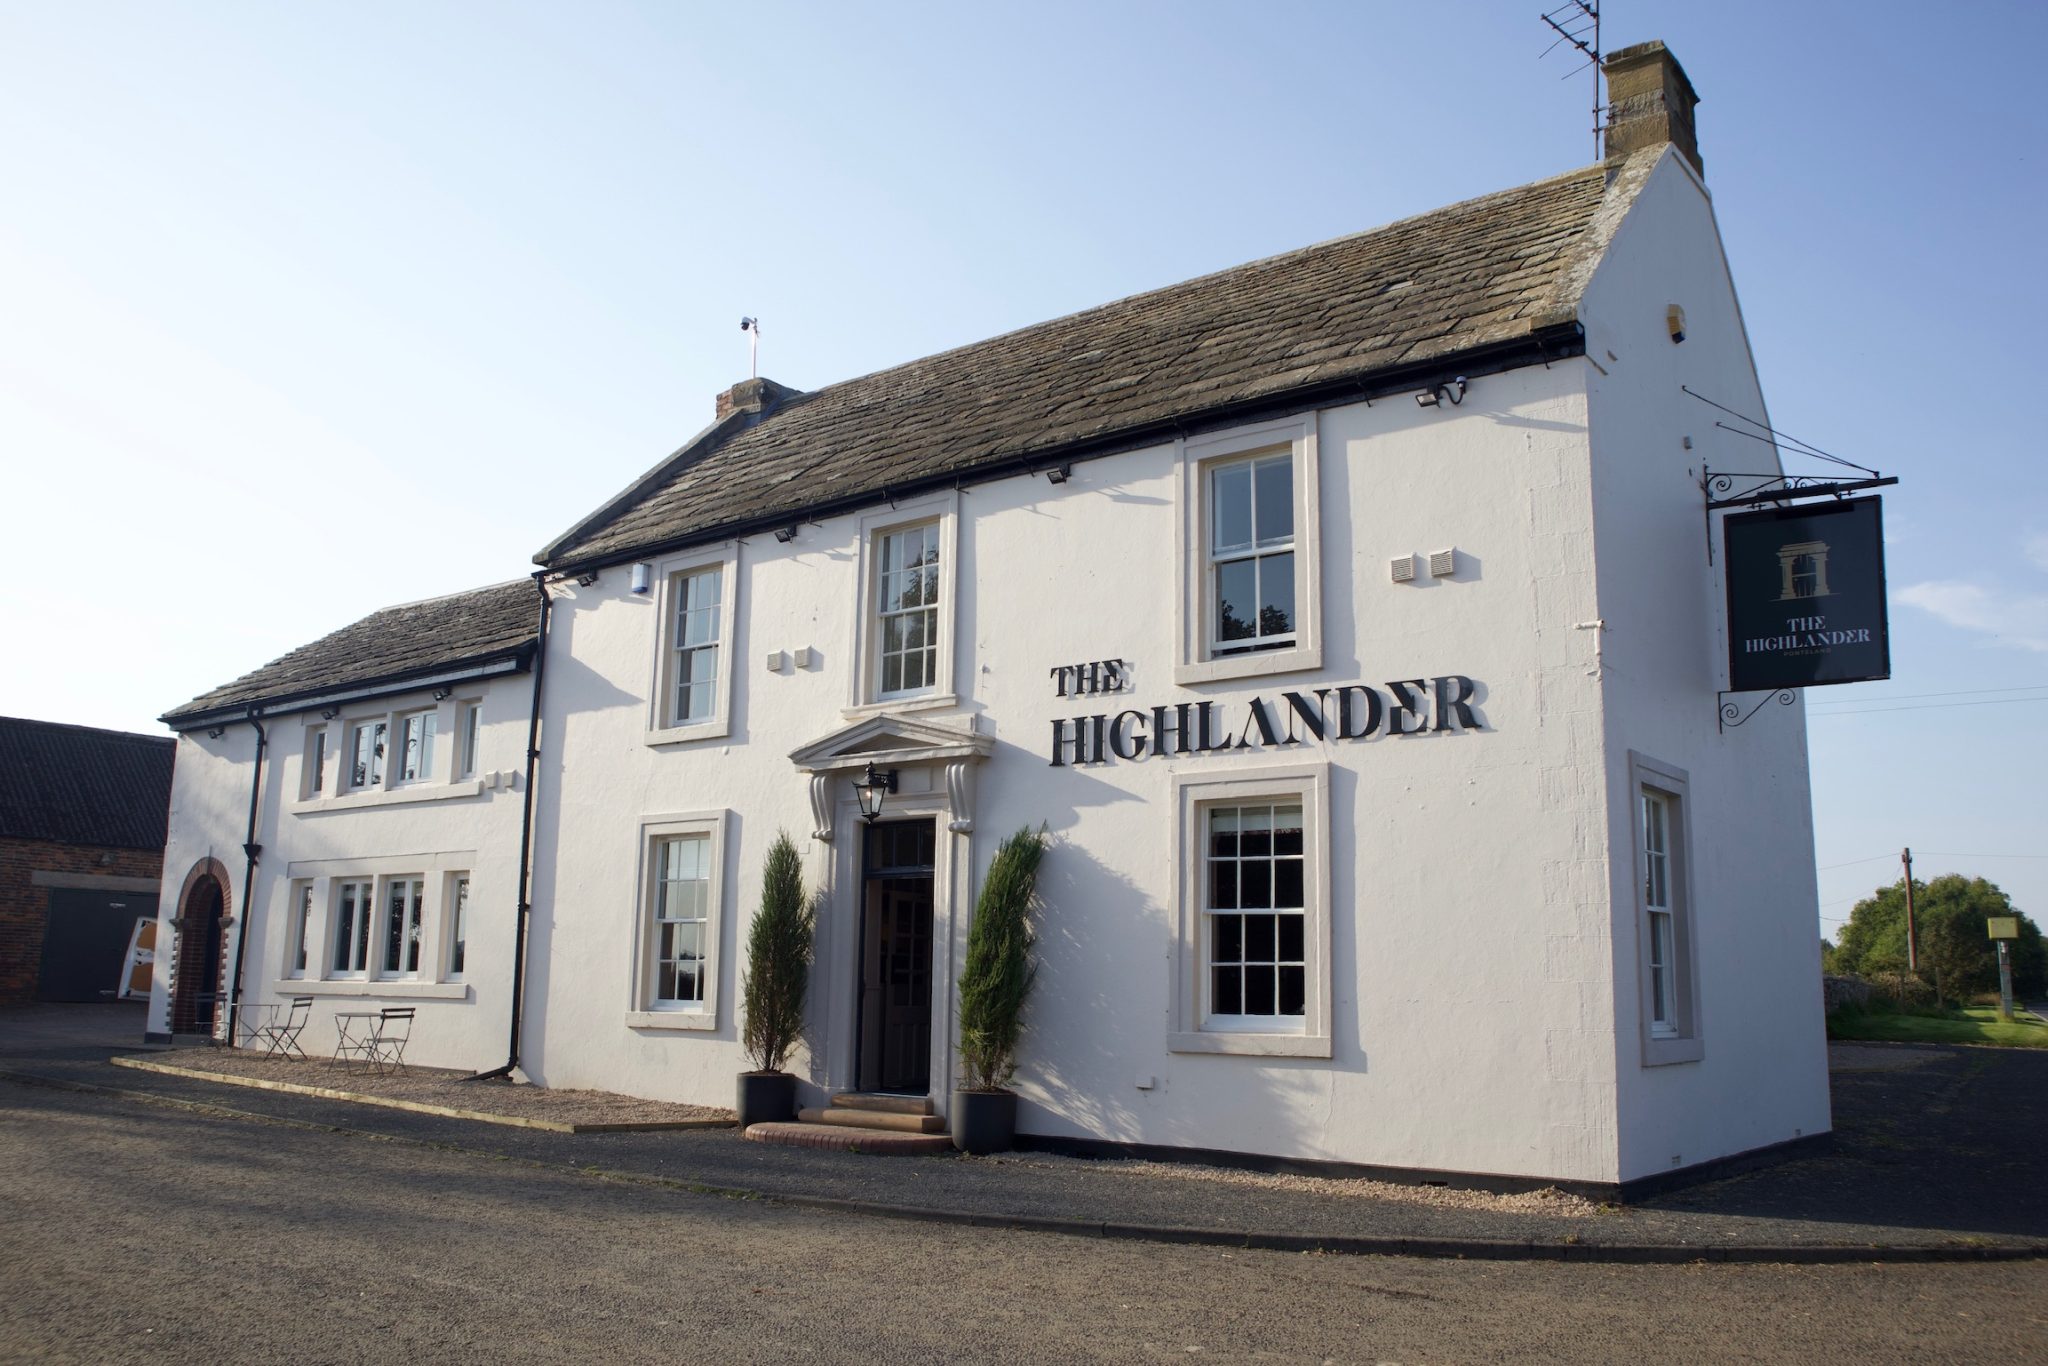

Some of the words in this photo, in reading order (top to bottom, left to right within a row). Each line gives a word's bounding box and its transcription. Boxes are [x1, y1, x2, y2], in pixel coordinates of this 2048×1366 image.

[1787, 616, 1826, 633] THE
[1746, 629, 1871, 653] HIGHLANDER
[1051, 659, 1123, 697] THE
[1049, 675, 1482, 767] HIGHLANDER
